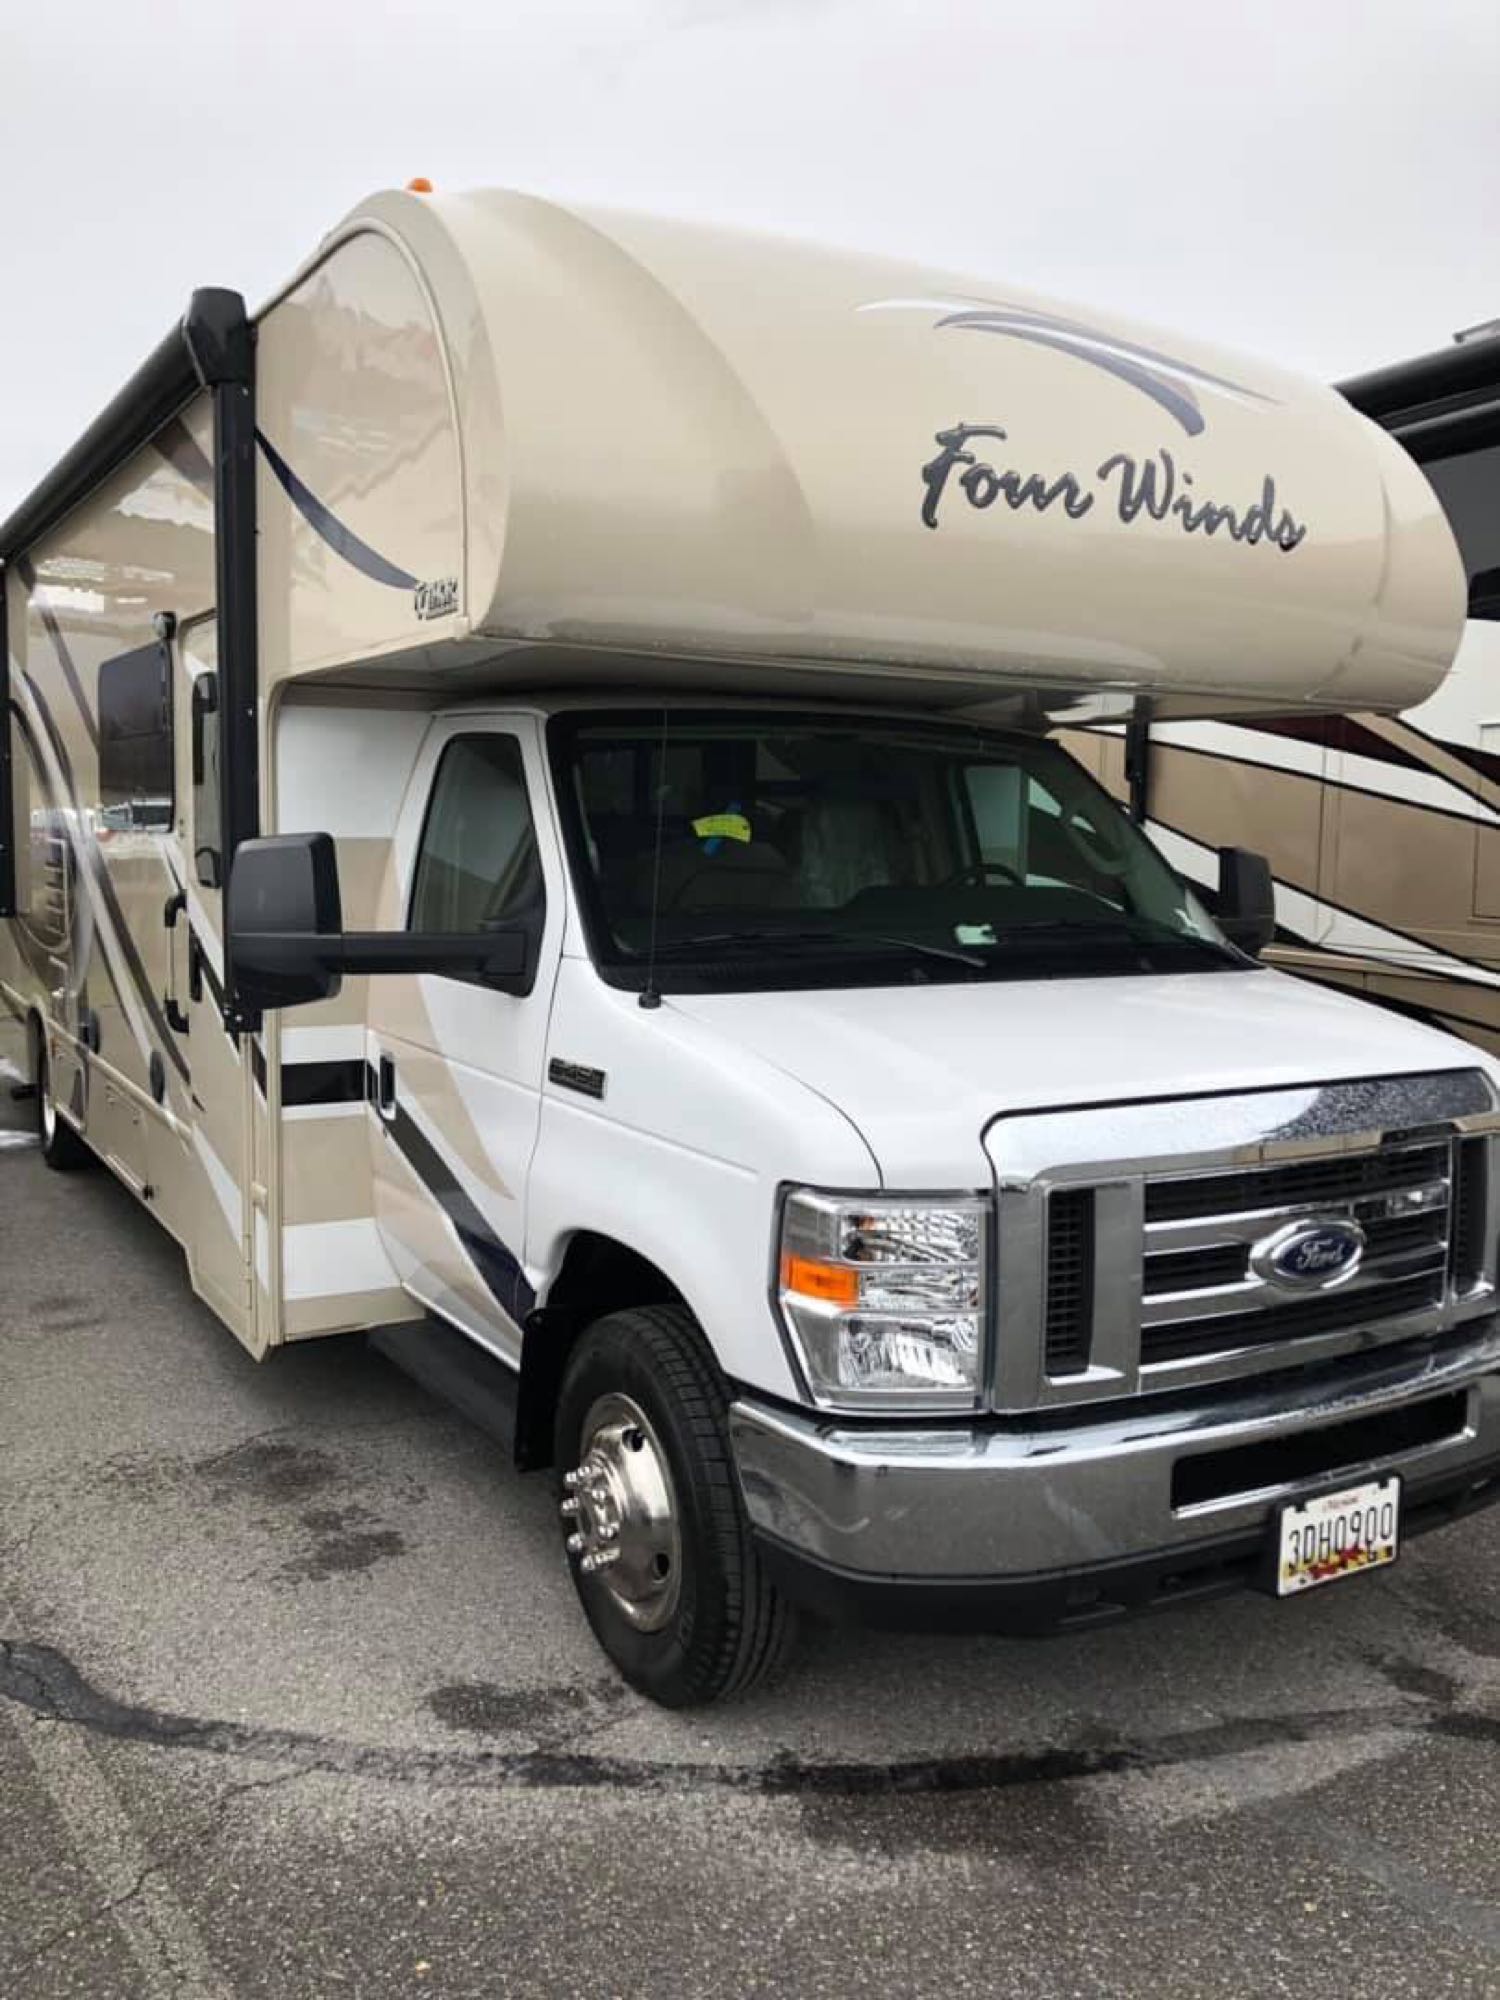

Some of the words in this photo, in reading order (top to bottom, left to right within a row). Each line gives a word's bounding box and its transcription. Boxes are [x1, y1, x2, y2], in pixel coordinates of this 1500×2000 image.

[921, 422, 1093, 529] Four
[1097, 448, 1306, 552] Winds
[1296, 1239, 1345, 1270] Ford
